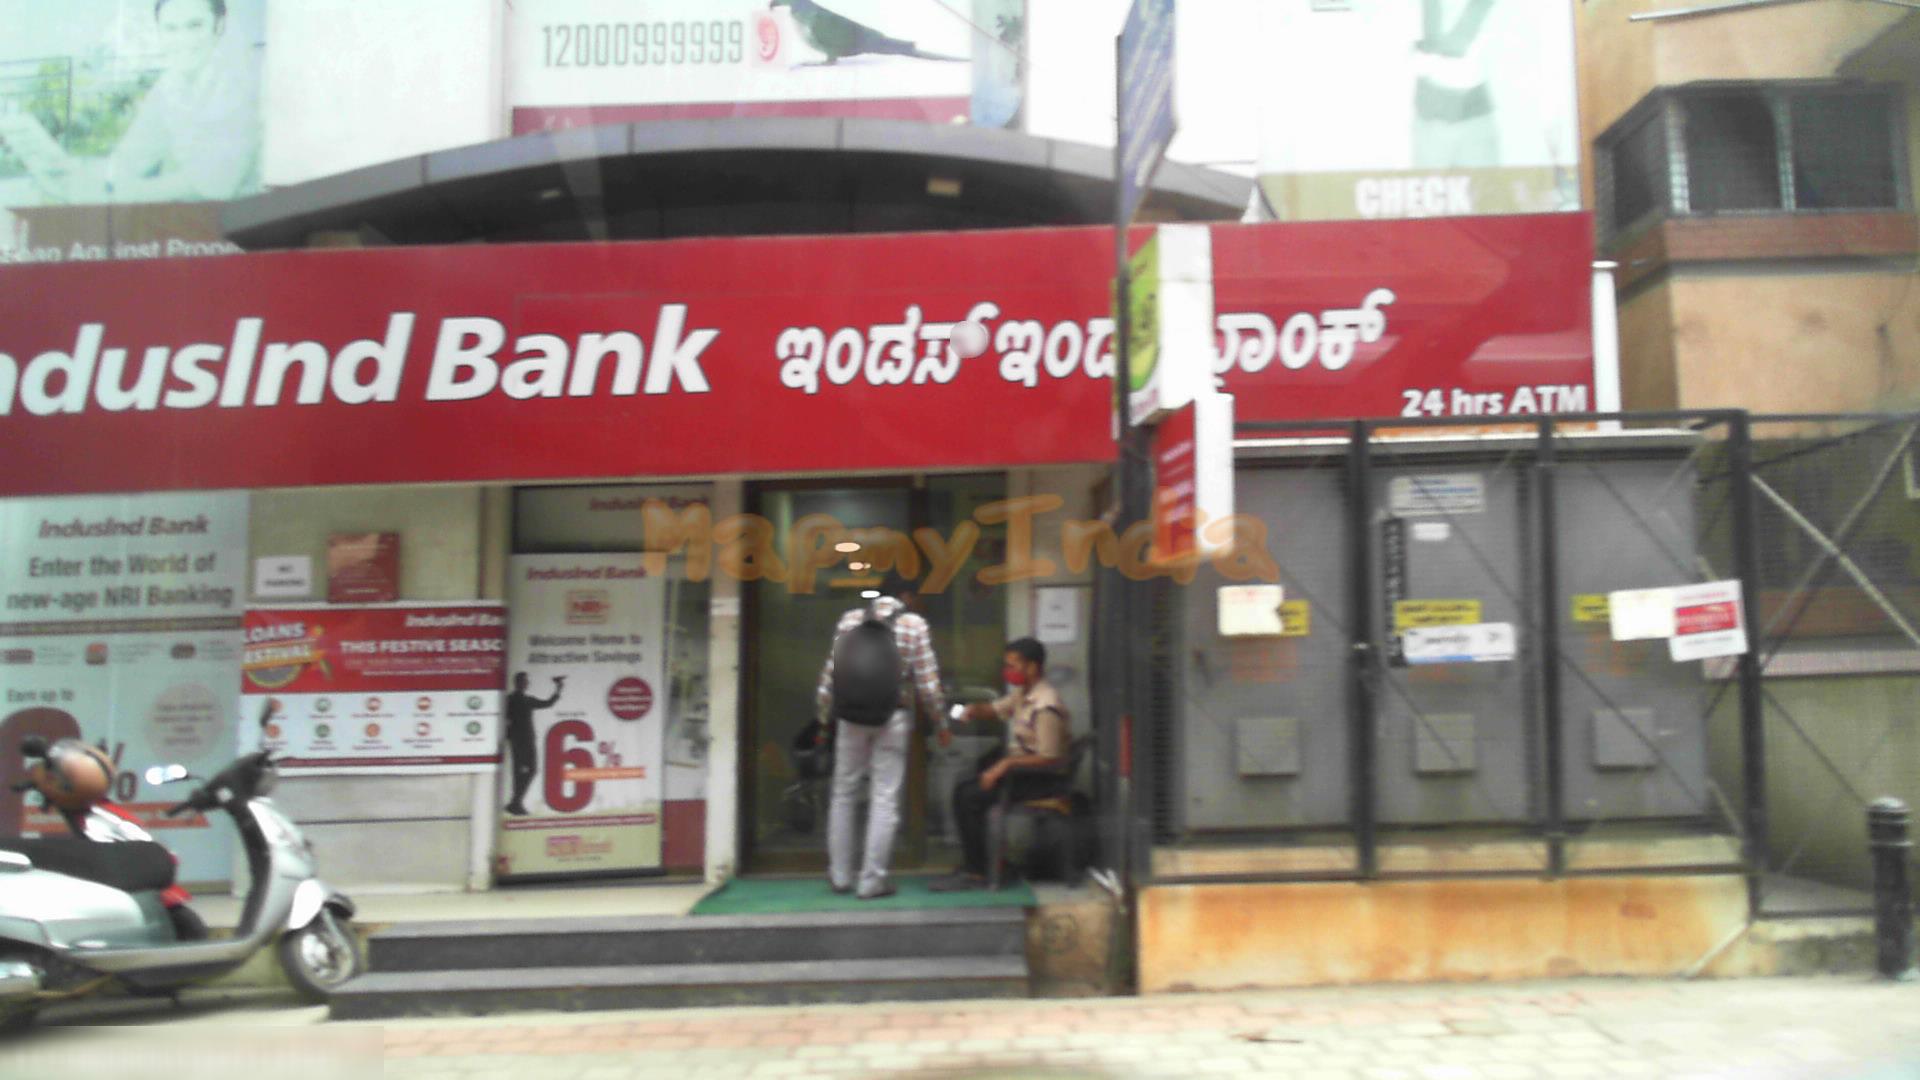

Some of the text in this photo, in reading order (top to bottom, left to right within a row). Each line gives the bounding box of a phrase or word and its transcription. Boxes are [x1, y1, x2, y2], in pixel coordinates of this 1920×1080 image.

[1355, 176, 1472, 219] CHECK
[0, 303, 721, 415] dusInd Bank
[1401, 384, 1587, 417] 24 hrs ATM
[39, 514, 209, 538] IndusInd Bank
[28, 552, 216, 577] Enter the World of
[6, 584, 234, 612] new-age NRI Banking
[340, 641, 378, 654] THIS
[381, 640, 446, 653] FESTIVE
